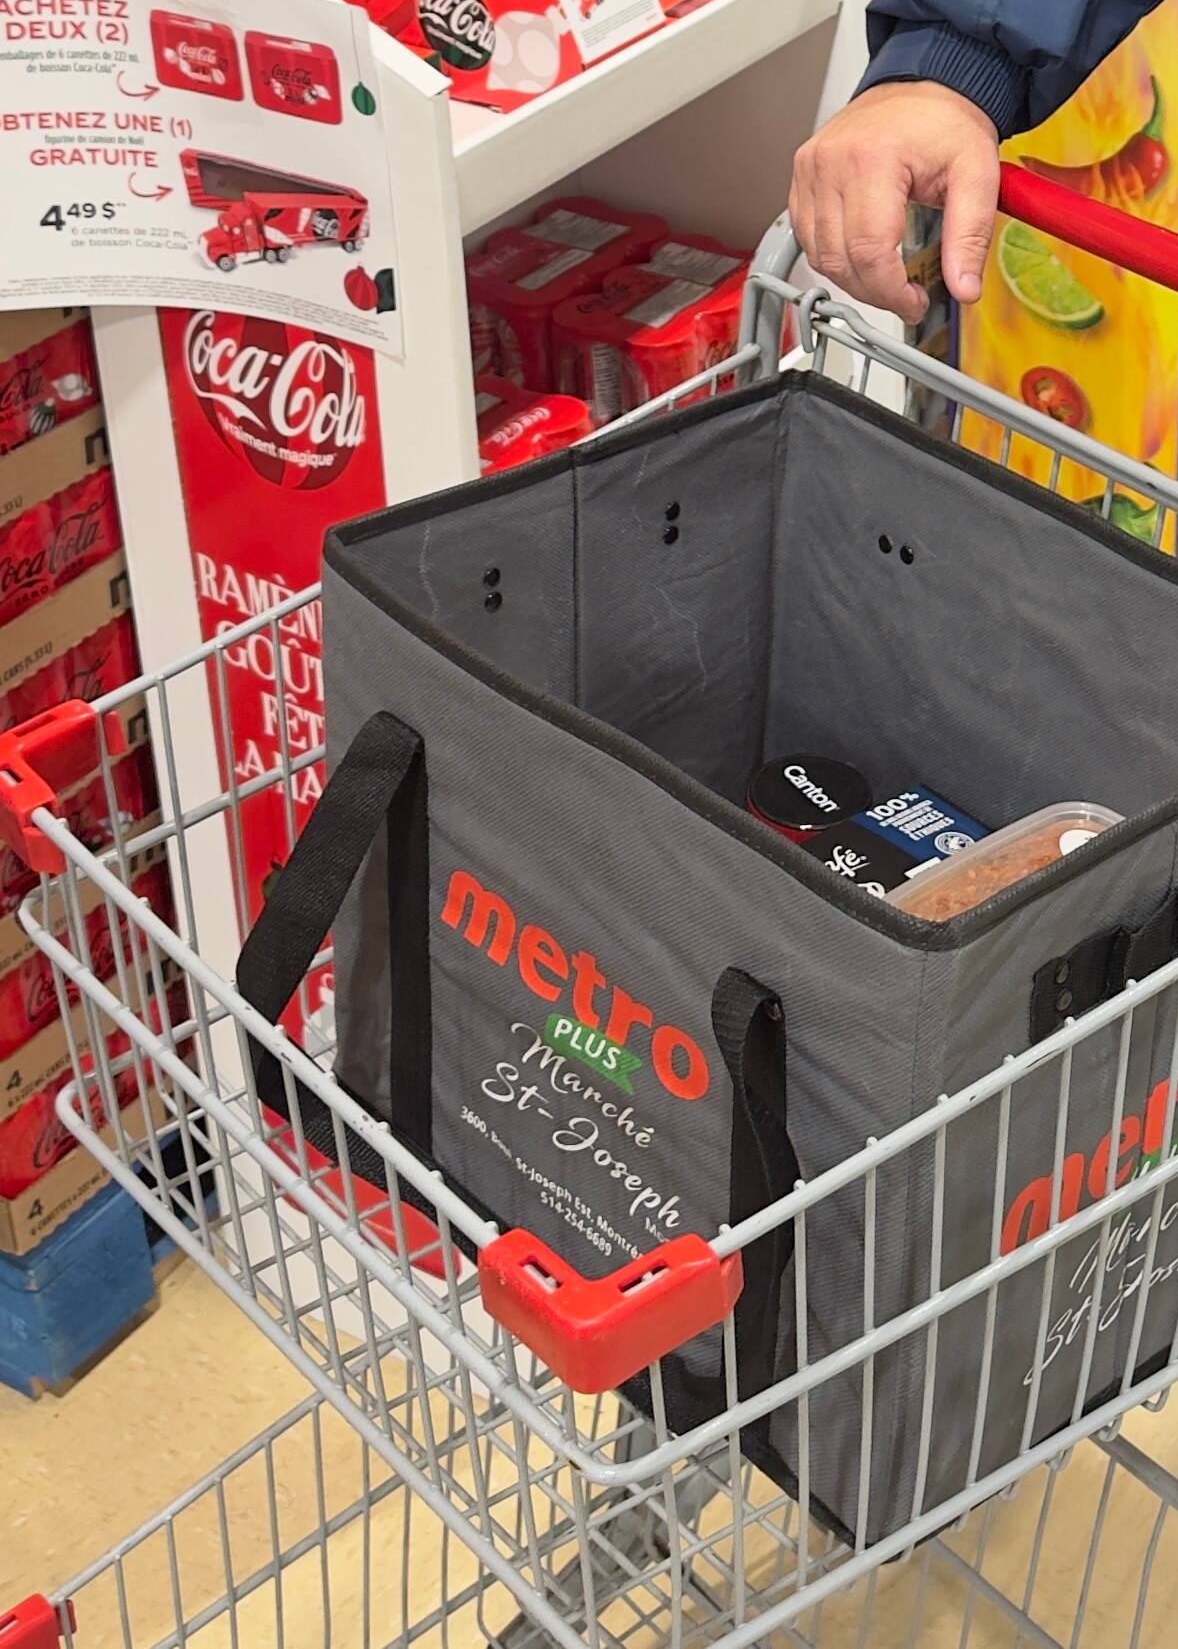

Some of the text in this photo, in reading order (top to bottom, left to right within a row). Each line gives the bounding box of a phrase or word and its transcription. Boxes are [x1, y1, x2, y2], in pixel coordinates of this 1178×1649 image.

[6, 20, 129, 45] DEUX (2)
[26, 64, 37, 74] de
[40, 62, 71, 73] boisson
[46, 49, 56, 59] de
[58, 48, 64, 59] 6
[67, 49, 101, 60] canettes
[102, 50, 111, 60] de
[271, 62, 313, 86] Coca-Cola
[0, 112, 193, 140] BTENEZ UNE (1)
[30, 148, 159, 168] GRATUITE
[71, 227, 79, 236] 6
[82, 226, 130, 237] canettes
[134, 226, 147, 236] de
[151, 228, 170, 238] 222
[71, 237, 85, 248] de
[89, 237, 132, 248] boisson
[183, 311, 367, 448] Coca-Cola
[219, 413, 336, 468] Vraiment magique
[196, 551, 323, 645] RAMÈN
[261, 690, 325, 751] FÊT
[783, 764, 840, 813] Canton
[865, 791, 920, 821] 100%
[898, 809, 945, 833] SOURCES
[440, 869, 710, 1101] metro
[553, 1017, 621, 1071] PLUS
[6, 1069, 23, 1091] 4
[511, 1022, 656, 1149] Marché
[459, 1105, 489, 1138] 3600,
[515, 1156, 573, 1204] St-Joseph
[596, 1215, 644, 1261] Montré
[27, 1197, 44, 1221] 4
[540, 1191, 614, 1257] 514-254-6689
